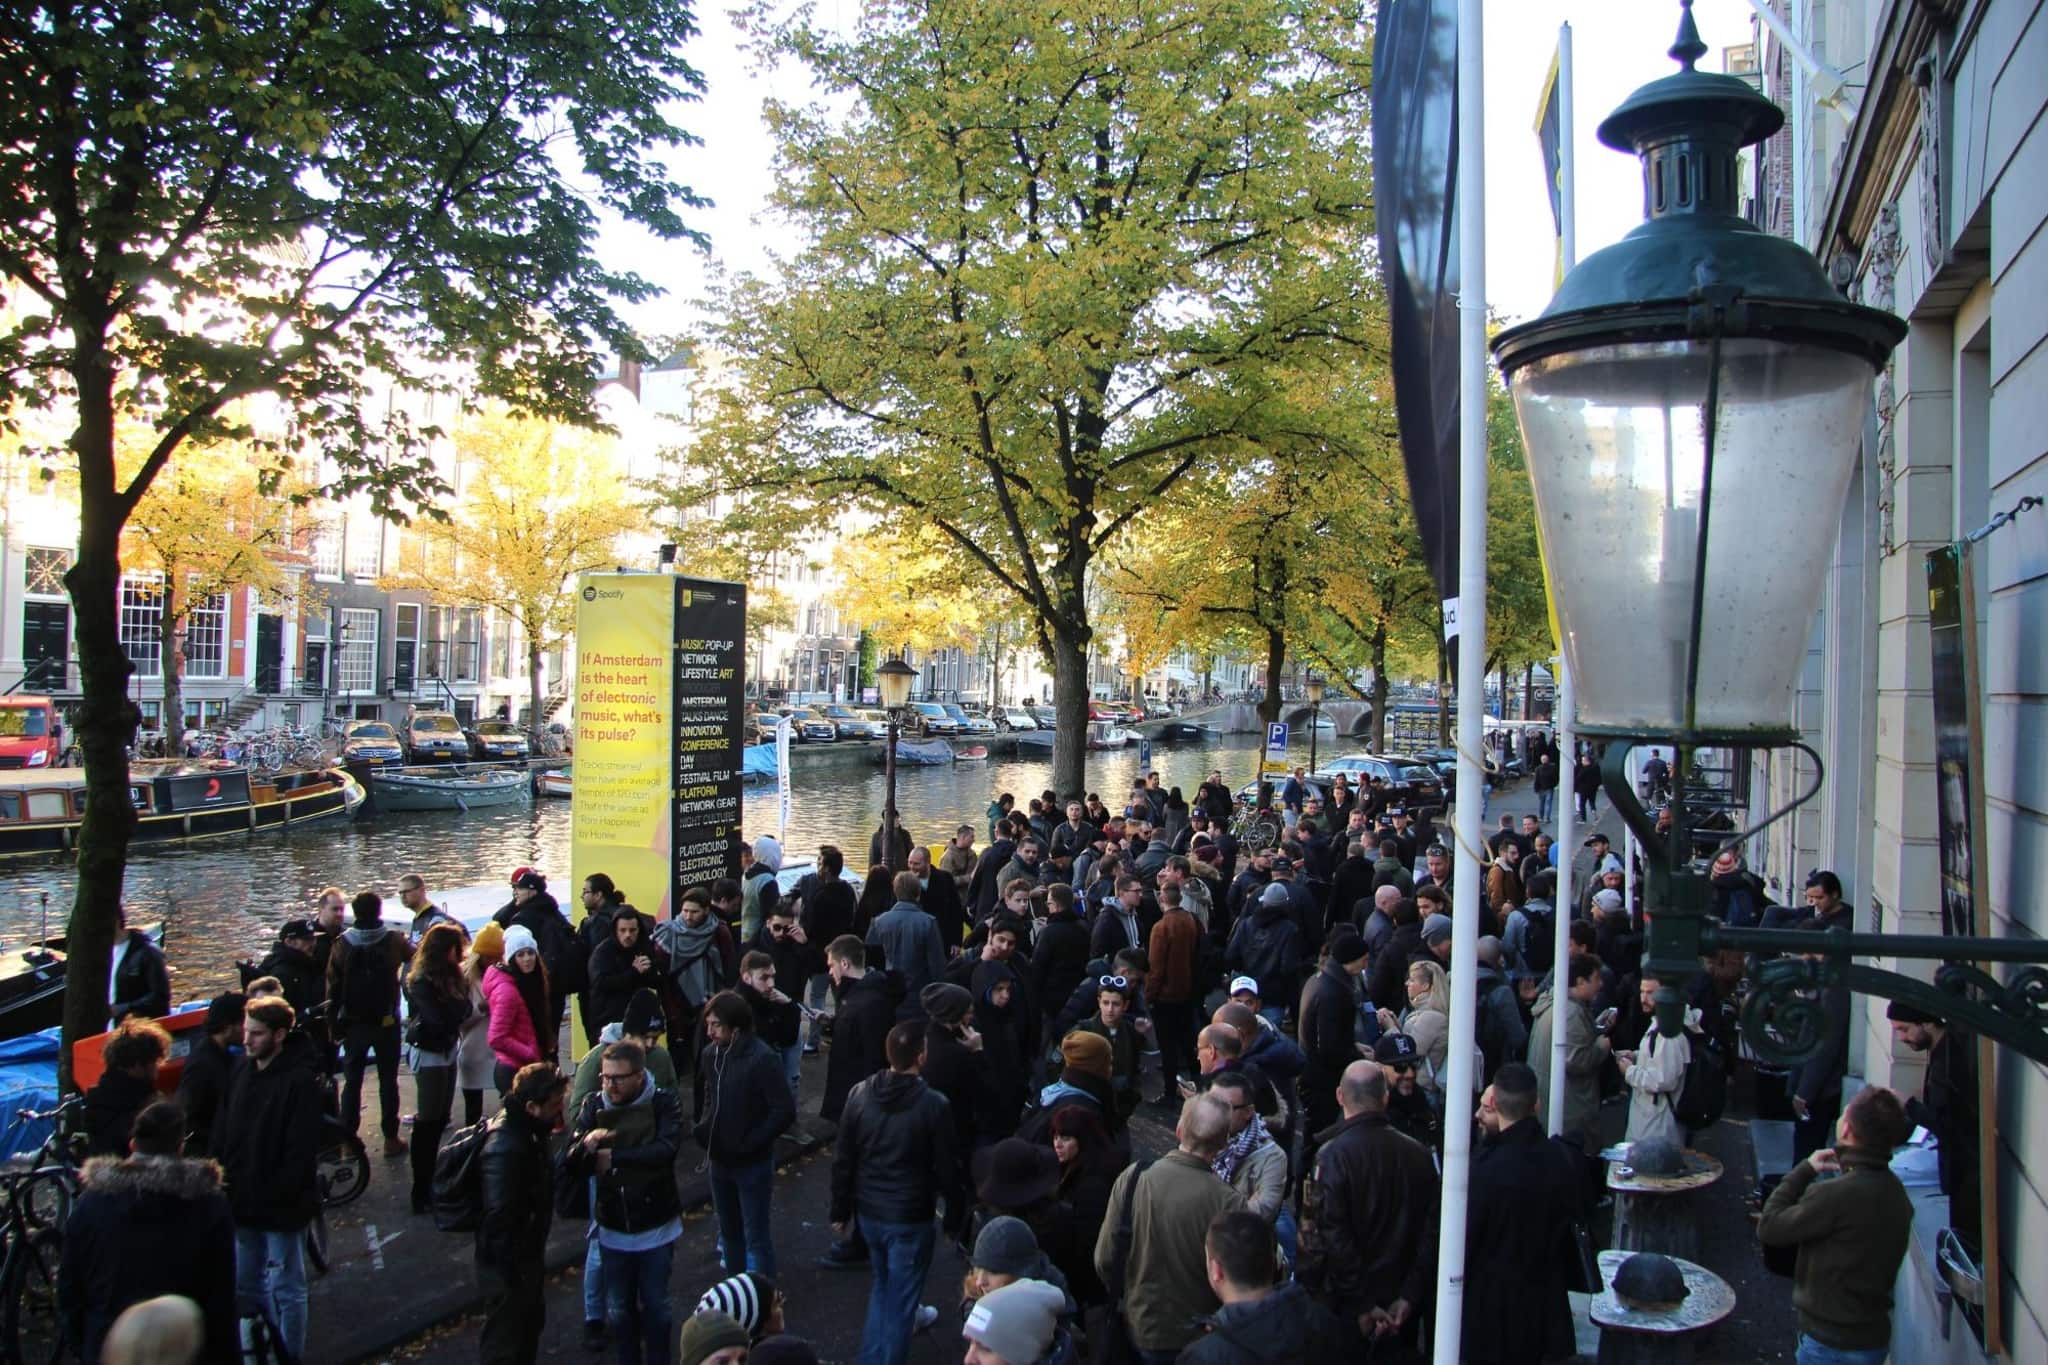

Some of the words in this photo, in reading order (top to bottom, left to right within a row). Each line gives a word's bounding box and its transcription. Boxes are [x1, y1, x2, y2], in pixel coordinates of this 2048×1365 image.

[599, 590, 624, 600] Spotify
[680, 639, 704, 650] MUSIC
[705, 640, 734, 651] POP-UP
[582, 652, 591, 665] If
[593, 653, 663, 667] Amsterdam
[681, 653, 718, 665] NETWORK
[581, 671, 591, 684] is
[594, 671, 614, 684] the
[616, 672, 648, 685] heart
[681, 667, 718, 679] LIFESTYLE
[719, 668, 735, 679] ART
[581, 689, 594, 703] of
[596, 690, 657, 705] electronic
[681, 696, 727, 706] AMSTERDAM
[580, 708, 621, 723] music,
[623, 709, 662, 724] what's
[681, 711, 703, 722] TALKS
[704, 710, 728, 721] DANCE
[580, 726, 595, 740] its
[597, 727, 636, 743] pulse?
[680, 725, 722, 737] INNOVATION
[1272, 724, 1284, 740] P
[680, 739, 729, 752] CONFERENCE
[679, 771, 712, 784] FESTIVAL
[713, 770, 730, 781] FILM
[679, 785, 718, 799] PLATFORM
[679, 799, 716, 813] NETWORK
[716, 797, 736, 809] GEAR
[715, 826, 726, 837] DJ
[679, 840, 728, 857] PLAYGROUND
[679, 854, 724, 871] ELECTRONIC
[679, 866, 728, 886] TECHNOLOGY
